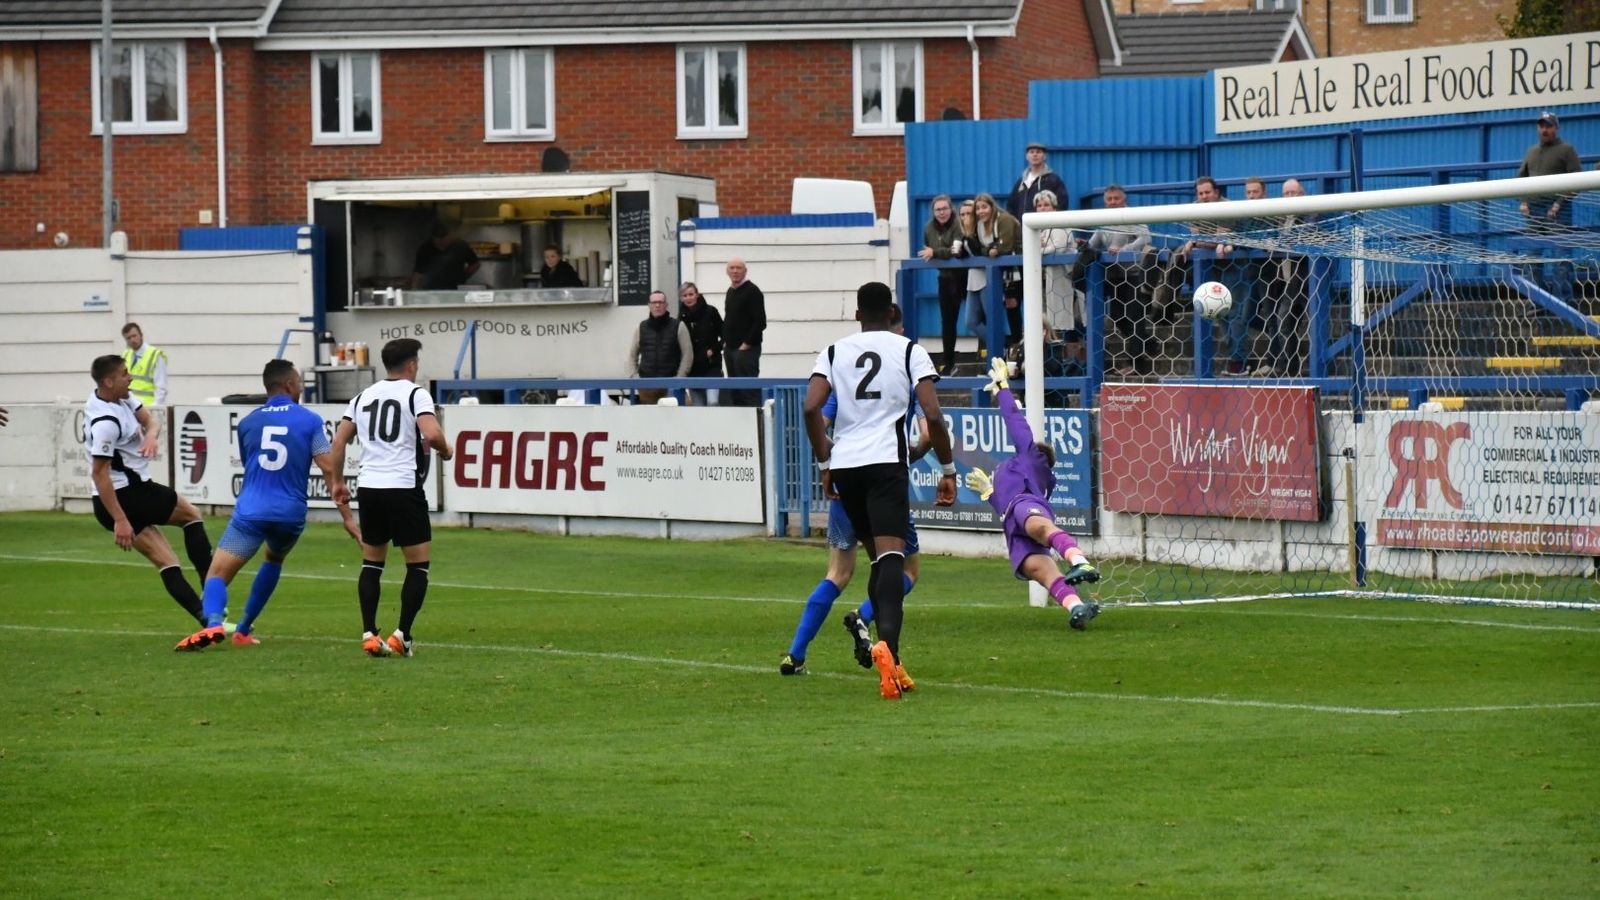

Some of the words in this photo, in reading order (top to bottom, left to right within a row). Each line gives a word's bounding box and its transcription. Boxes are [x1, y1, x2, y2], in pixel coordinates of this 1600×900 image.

[1221, 72, 1279, 122] Real
[1289, 67, 1338, 116] Ale
[1352, 58, 1412, 109] Real
[1422, 50, 1494, 104] Food
[1509, 42, 1574, 97] Real
[380, 326, 410, 340] HOT
[414, 324, 424, 336] &
[429, 319, 467, 334] COLD
[475, 320, 516, 336] FOOD
[520, 324, 531, 336] &
[536, 320, 589, 337] DRINKS
[855, 351, 882, 400] 2
[362, 398, 401, 443] 10
[962, 414, 1083, 455] BUILRS
[1514, 426, 1533, 440] FOR
[1536, 427, 1554, 441] ALL
[1555, 427, 1582, 441] YOUR
[258, 426, 288, 471] 5
[454, 430, 608, 491] EAGRE
[615, 440, 658, 454] Affordable
[660, 441, 688, 458] Quality
[690, 442, 716, 456] Coach
[718, 443, 754, 460] Holidays
[1170, 413, 1236, 493] Wright
[1240, 415, 1294, 496] Vigar
[1484, 447, 1548, 462] COMMERCIAL
[1551, 449, 1557, 462] &
[616, 465, 684, 482] www.eagre.co.uk
[698, 466, 722, 481] 01427
[725, 467, 755, 482] 612098
[1483, 469, 1540, 484] ELECTRICAL
[1543, 471, 1600, 485] REQUIREME
[1493, 494, 1542, 515] 01427
[1547, 495, 1600, 516] 67114
